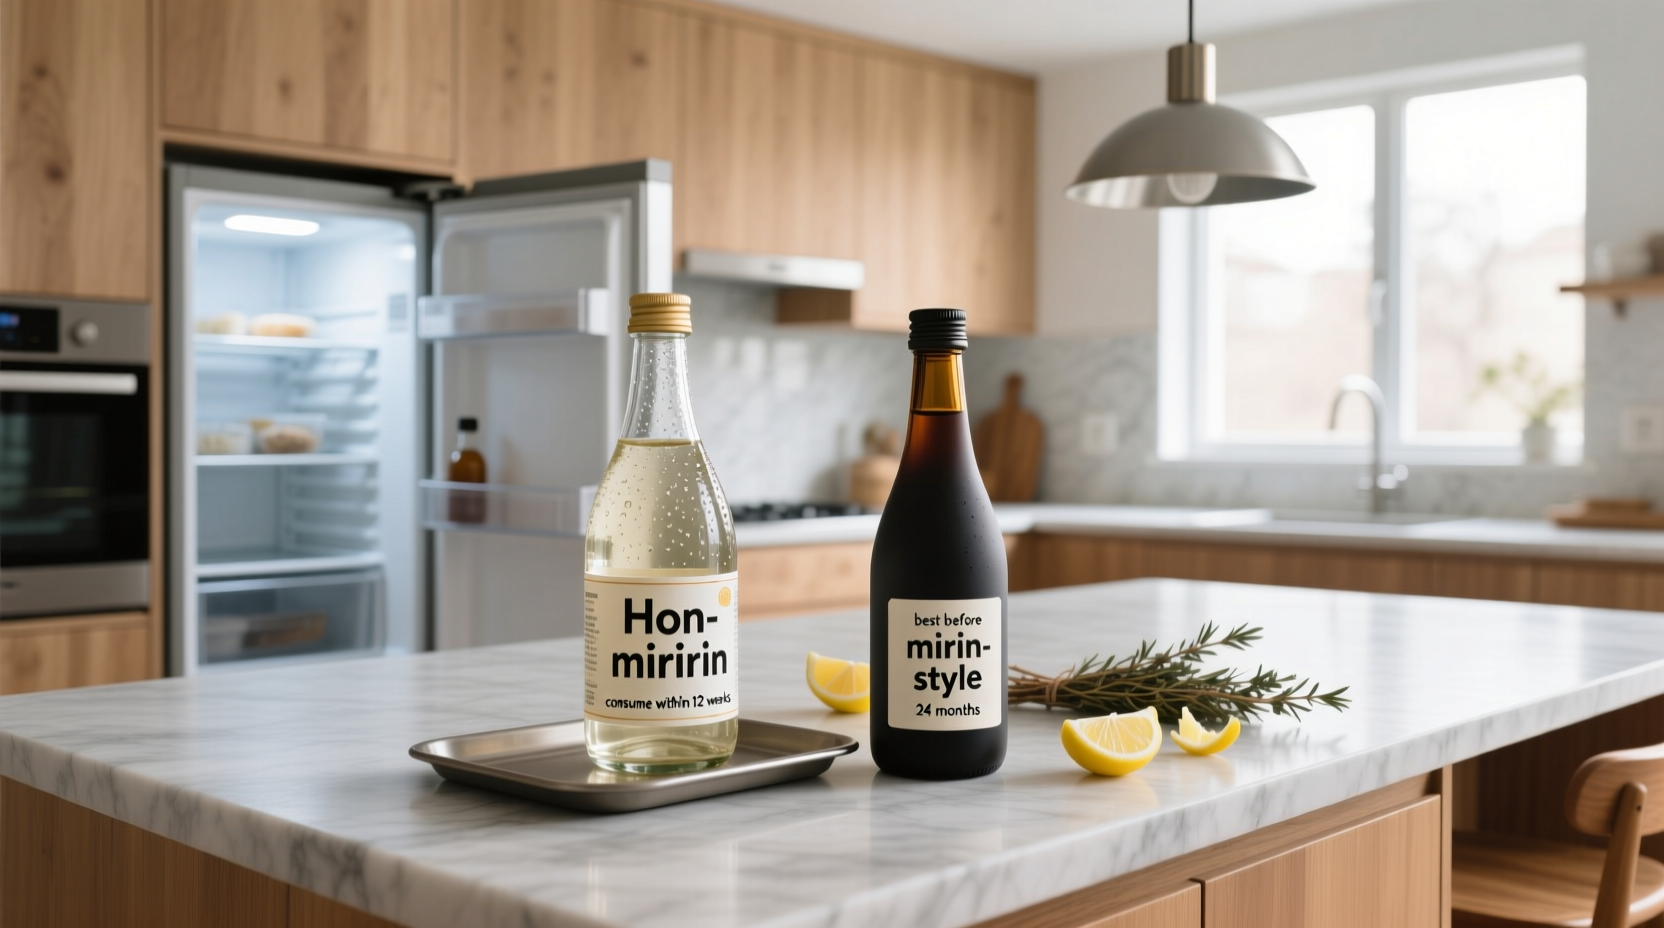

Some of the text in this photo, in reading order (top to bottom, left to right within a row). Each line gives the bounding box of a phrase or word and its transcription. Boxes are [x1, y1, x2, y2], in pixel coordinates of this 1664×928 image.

[624, 597, 718, 636] Hon-
[914, 612, 982, 627] best before
[611, 640, 728, 679] miririn
[906, 631, 991, 660] mirin-
[913, 663, 983, 699] style
[605, 698, 653, 710] consume
[692, 694, 705, 708] 12
[915, 702, 981, 717] 24 months
